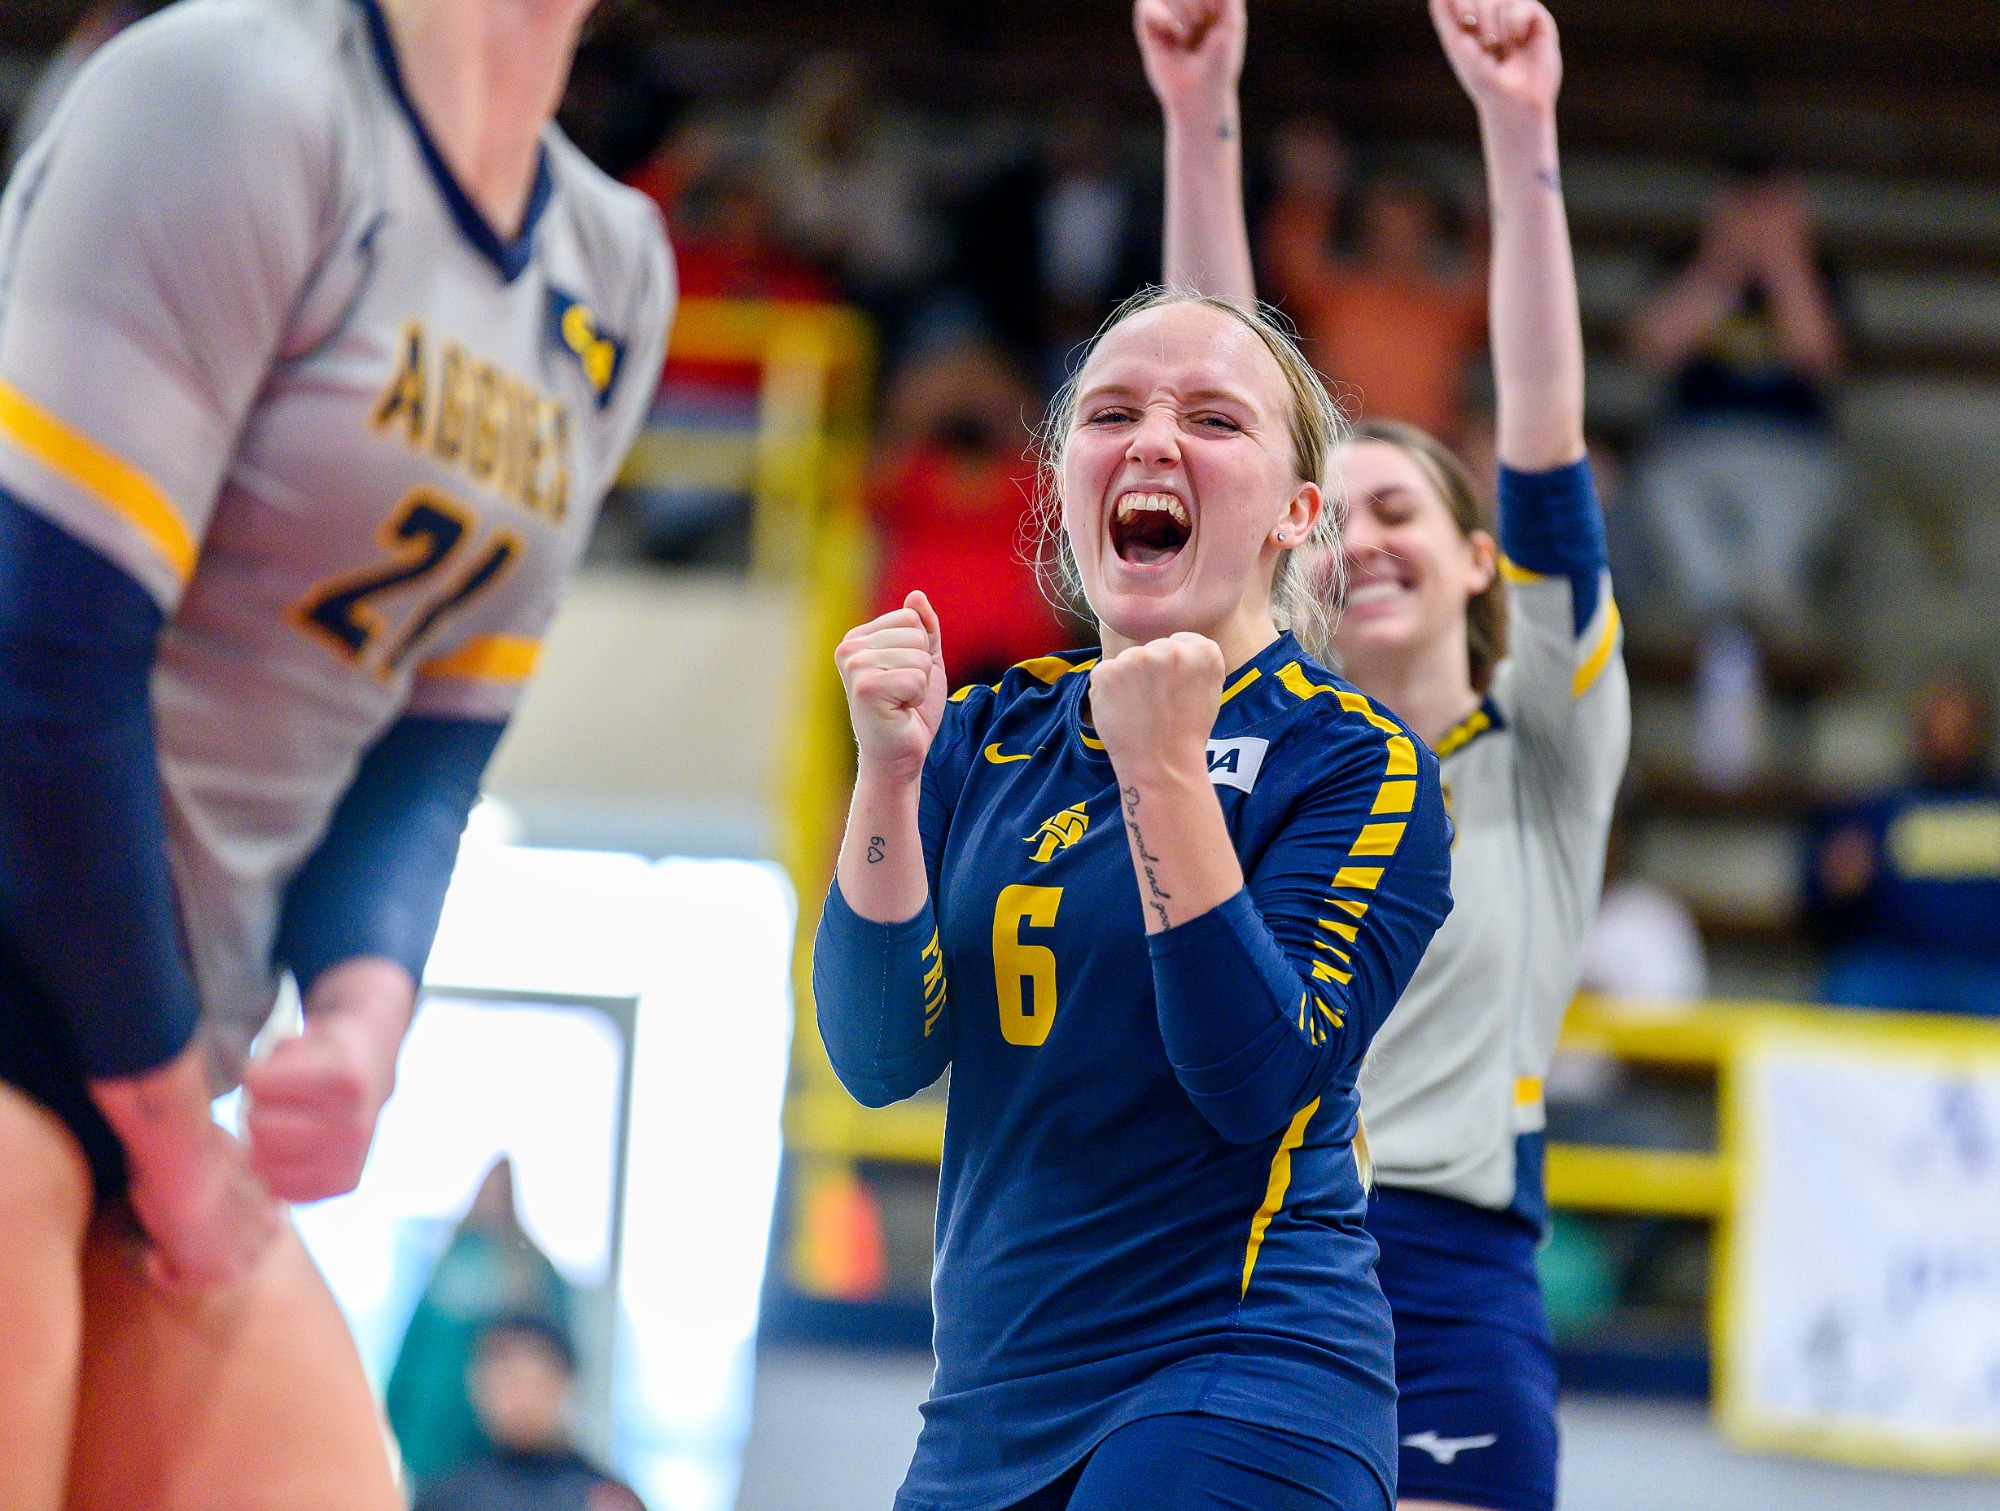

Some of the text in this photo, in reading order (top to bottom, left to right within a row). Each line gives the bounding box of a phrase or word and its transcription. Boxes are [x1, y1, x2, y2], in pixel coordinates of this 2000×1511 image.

[285, 484, 526, 686] 21
[1122, 786, 1140, 817] Do
[1126, 820, 1159, 862] good
[1145, 866, 1171, 898] and
[992, 884, 1064, 1046] 6
